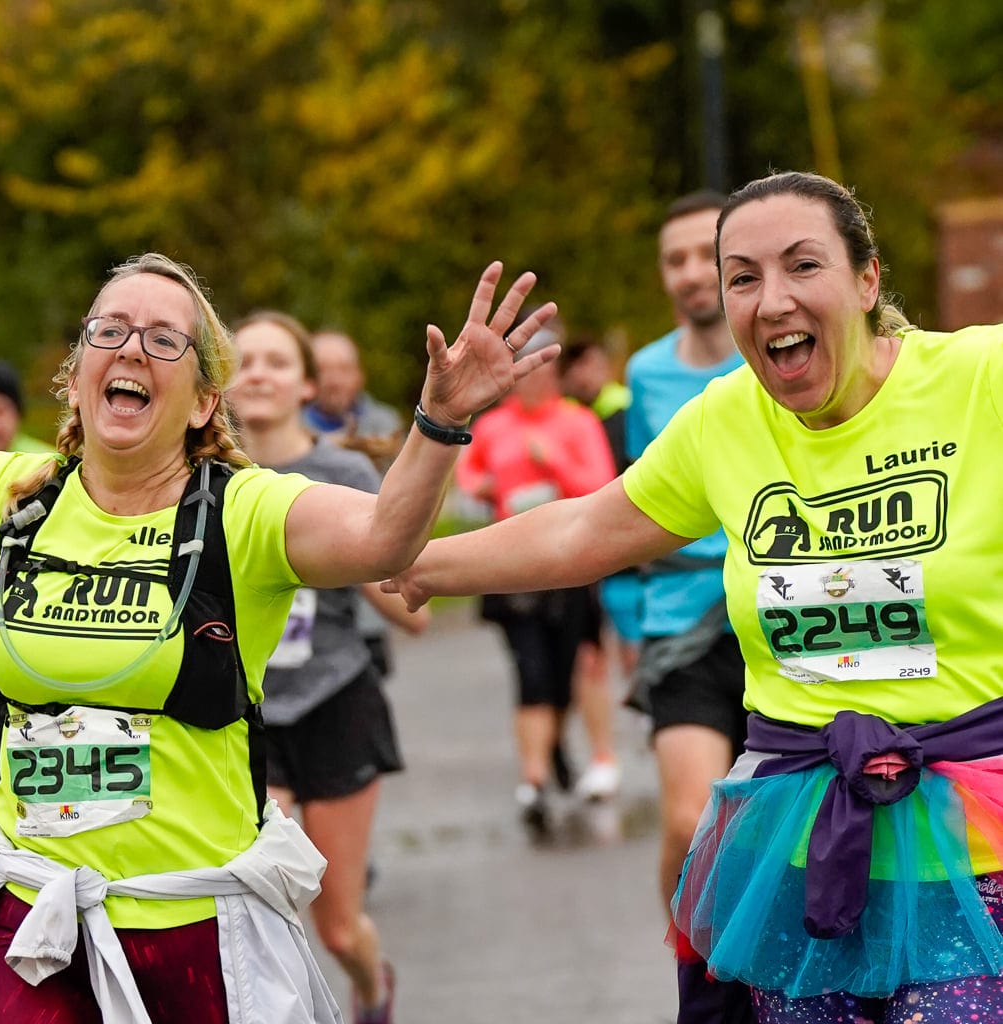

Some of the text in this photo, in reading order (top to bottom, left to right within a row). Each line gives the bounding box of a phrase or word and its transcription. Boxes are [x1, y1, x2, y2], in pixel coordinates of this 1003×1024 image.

[865, 440, 958, 475] Laurie
[826, 490, 913, 534] RUN
[818, 523, 927, 551] SANDYMOOR
[62, 575, 151, 607] RUN
[42, 604, 160, 624] SANDYMOOR
[764, 602, 921, 654] 2249
[837, 660, 860, 669] KIND
[899, 667, 931, 678] 2249
[12, 746, 144, 796] 2345
[59, 811, 80, 820] KIND
